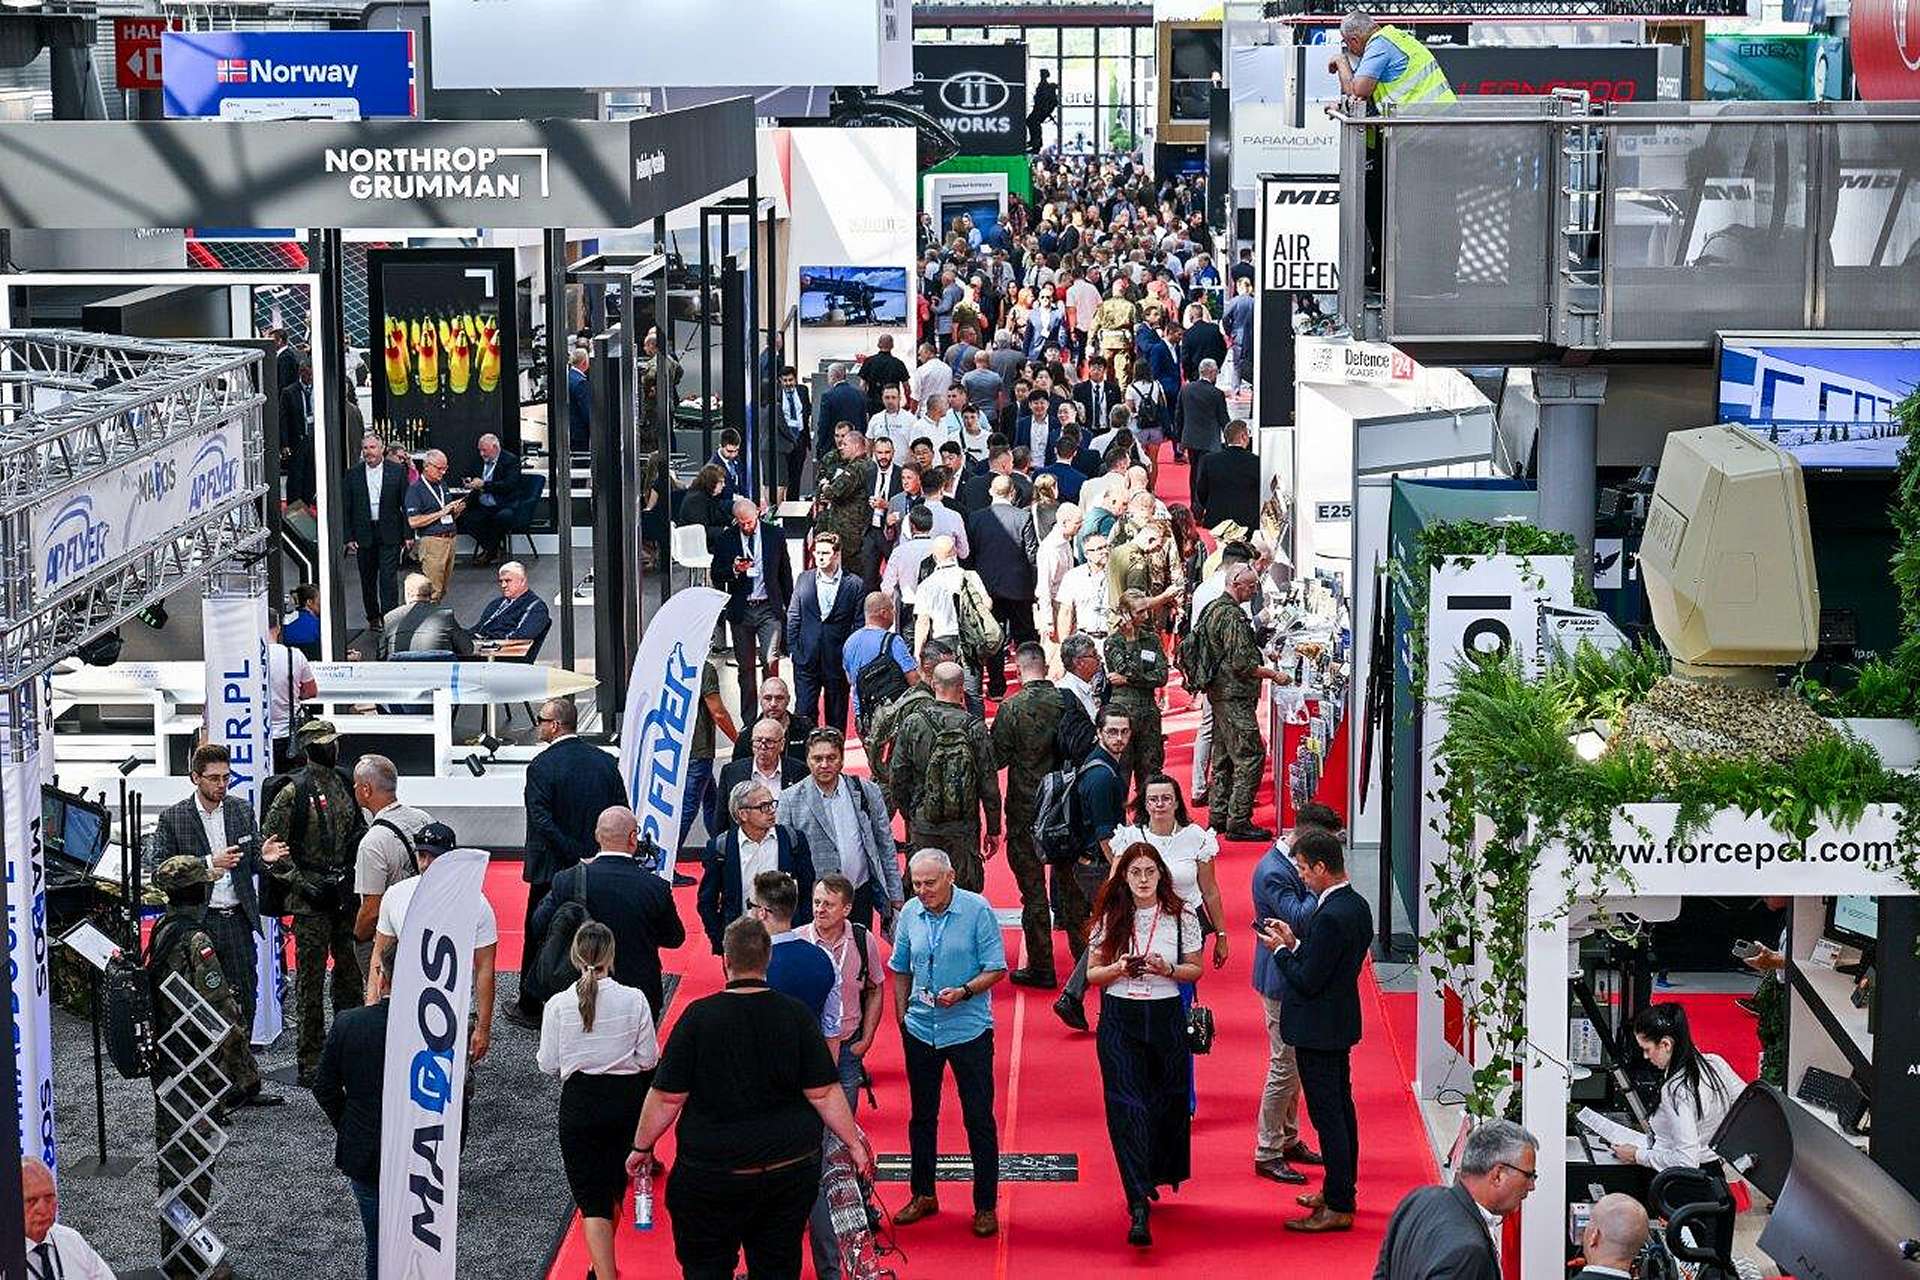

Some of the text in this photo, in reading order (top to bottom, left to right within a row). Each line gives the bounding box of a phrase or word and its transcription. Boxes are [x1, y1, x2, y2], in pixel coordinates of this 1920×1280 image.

[251, 59, 358, 88] Norway
[961, 77, 989, 107] 11
[940, 117, 1010, 133] WORKS
[1243, 136, 1335, 145] PARAMOUNT
[325, 148, 497, 173] NORTHROP
[350, 174, 520, 199] GRUMMAN
[1275, 190, 1340, 205] MB
[1273, 234, 1310, 261] AIR
[1345, 348, 1390, 369] Defence
[1319, 505, 1352, 518] E25
